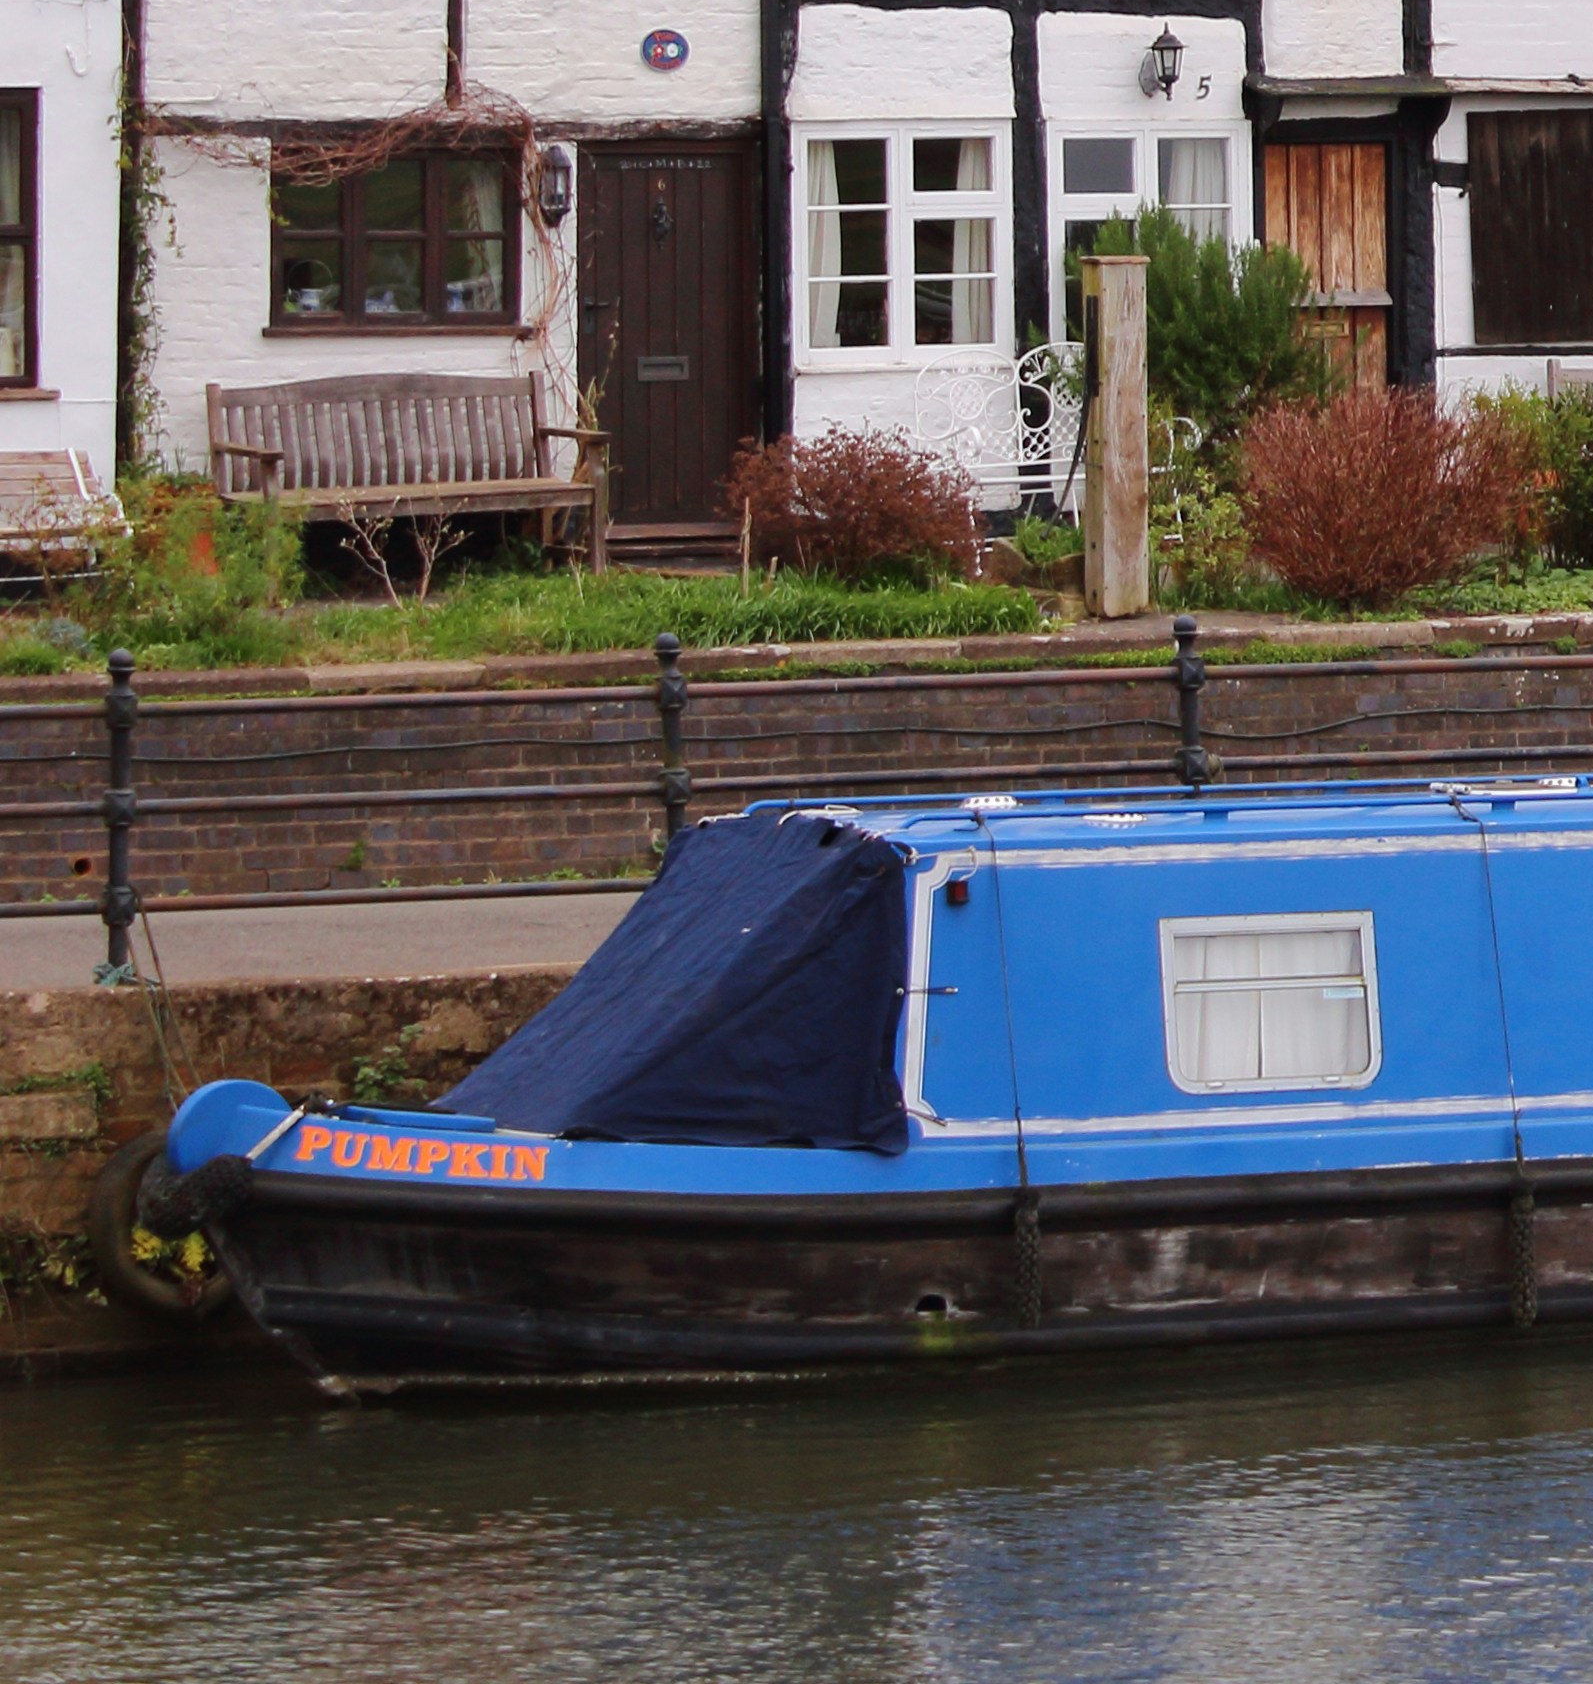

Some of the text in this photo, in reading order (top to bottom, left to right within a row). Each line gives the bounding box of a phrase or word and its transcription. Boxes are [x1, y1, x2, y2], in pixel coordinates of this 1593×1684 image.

[1195, 74, 1212, 100] 5
[657, 178, 666, 191] 6
[295, 1125, 549, 1181] PUMPKIN
